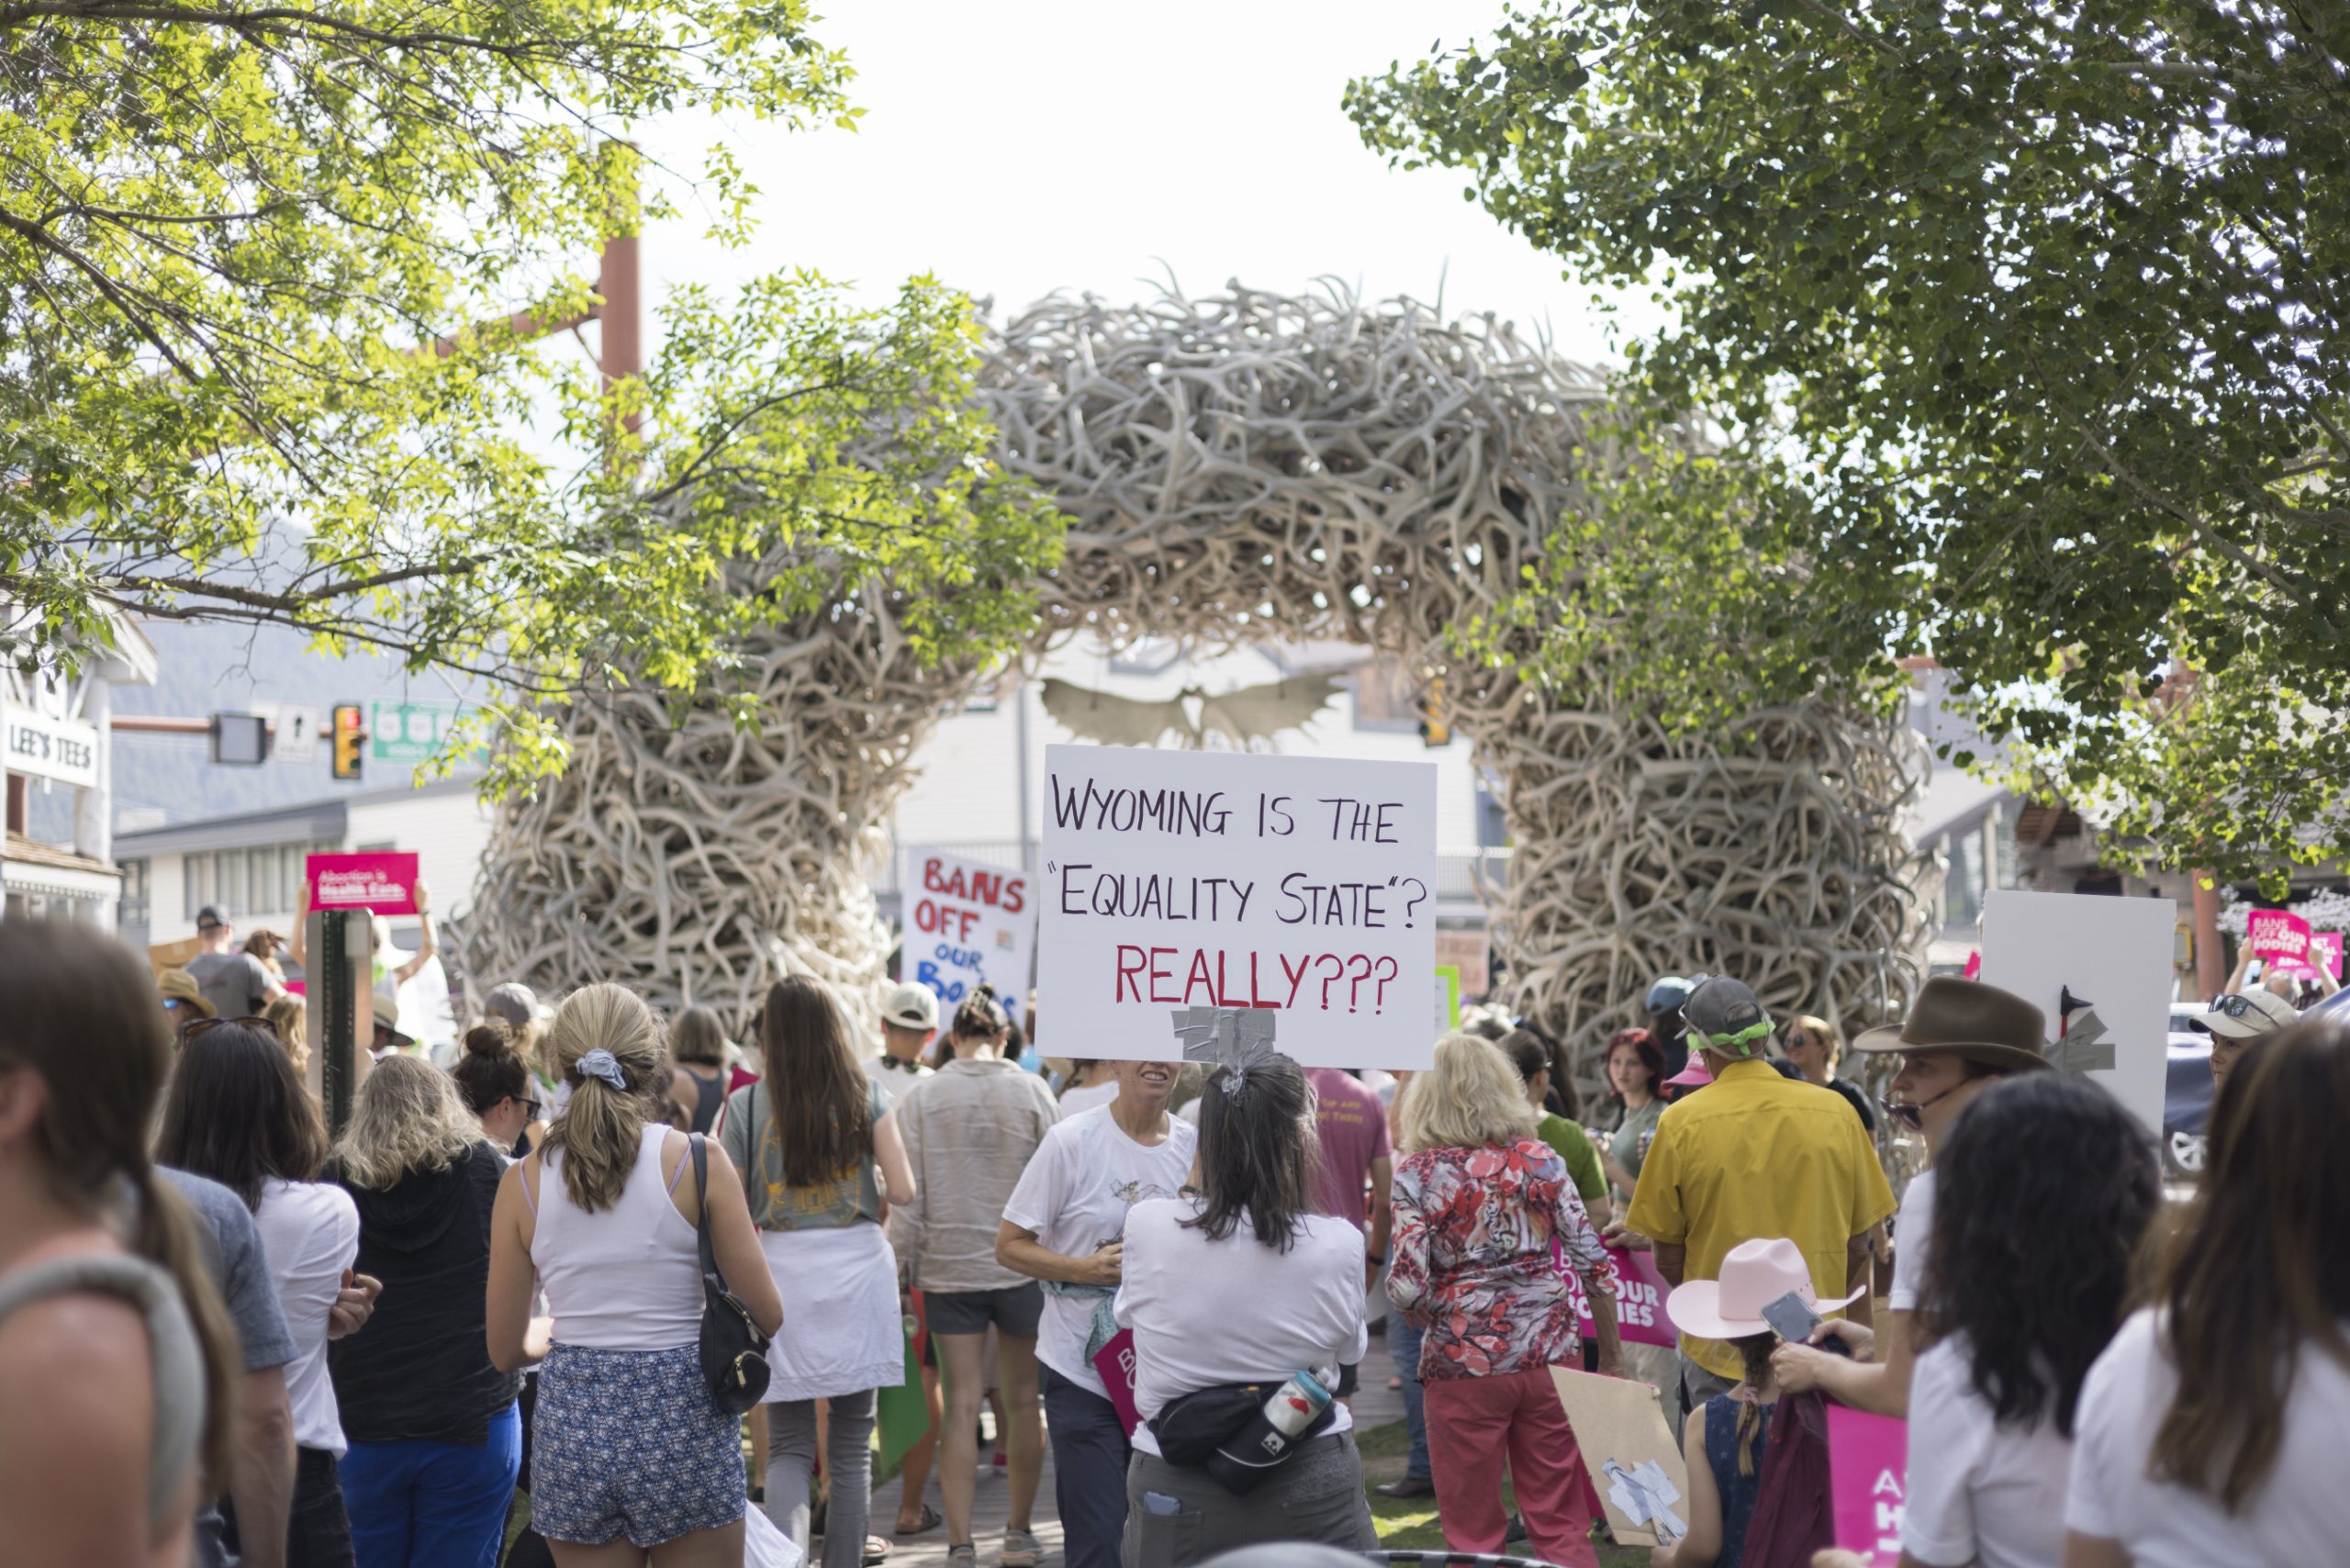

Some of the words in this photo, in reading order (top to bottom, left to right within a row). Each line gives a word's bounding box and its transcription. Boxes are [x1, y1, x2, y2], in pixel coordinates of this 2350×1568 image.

[10, 723, 51, 759] LEE'S
[57, 736, 91, 769] TEES
[1051, 773, 1234, 837] WYOMING
[1258, 792, 1295, 838] IS
[1316, 797, 1404, 844] THE
[924, 857, 1024, 913] BANS
[1046, 859, 1255, 923] "EQUALITY
[1274, 871, 1427, 929] STATE"?
[915, 900, 979, 943] OFF
[2254, 918, 2289, 930] BANS
[2254, 929, 2277, 940] OFF
[2277, 928, 2308, 946] OUR
[934, 943, 984, 973] OUR
[2254, 938, 2302, 955] BODIES
[1115, 944, 1399, 1016] REALLY???
